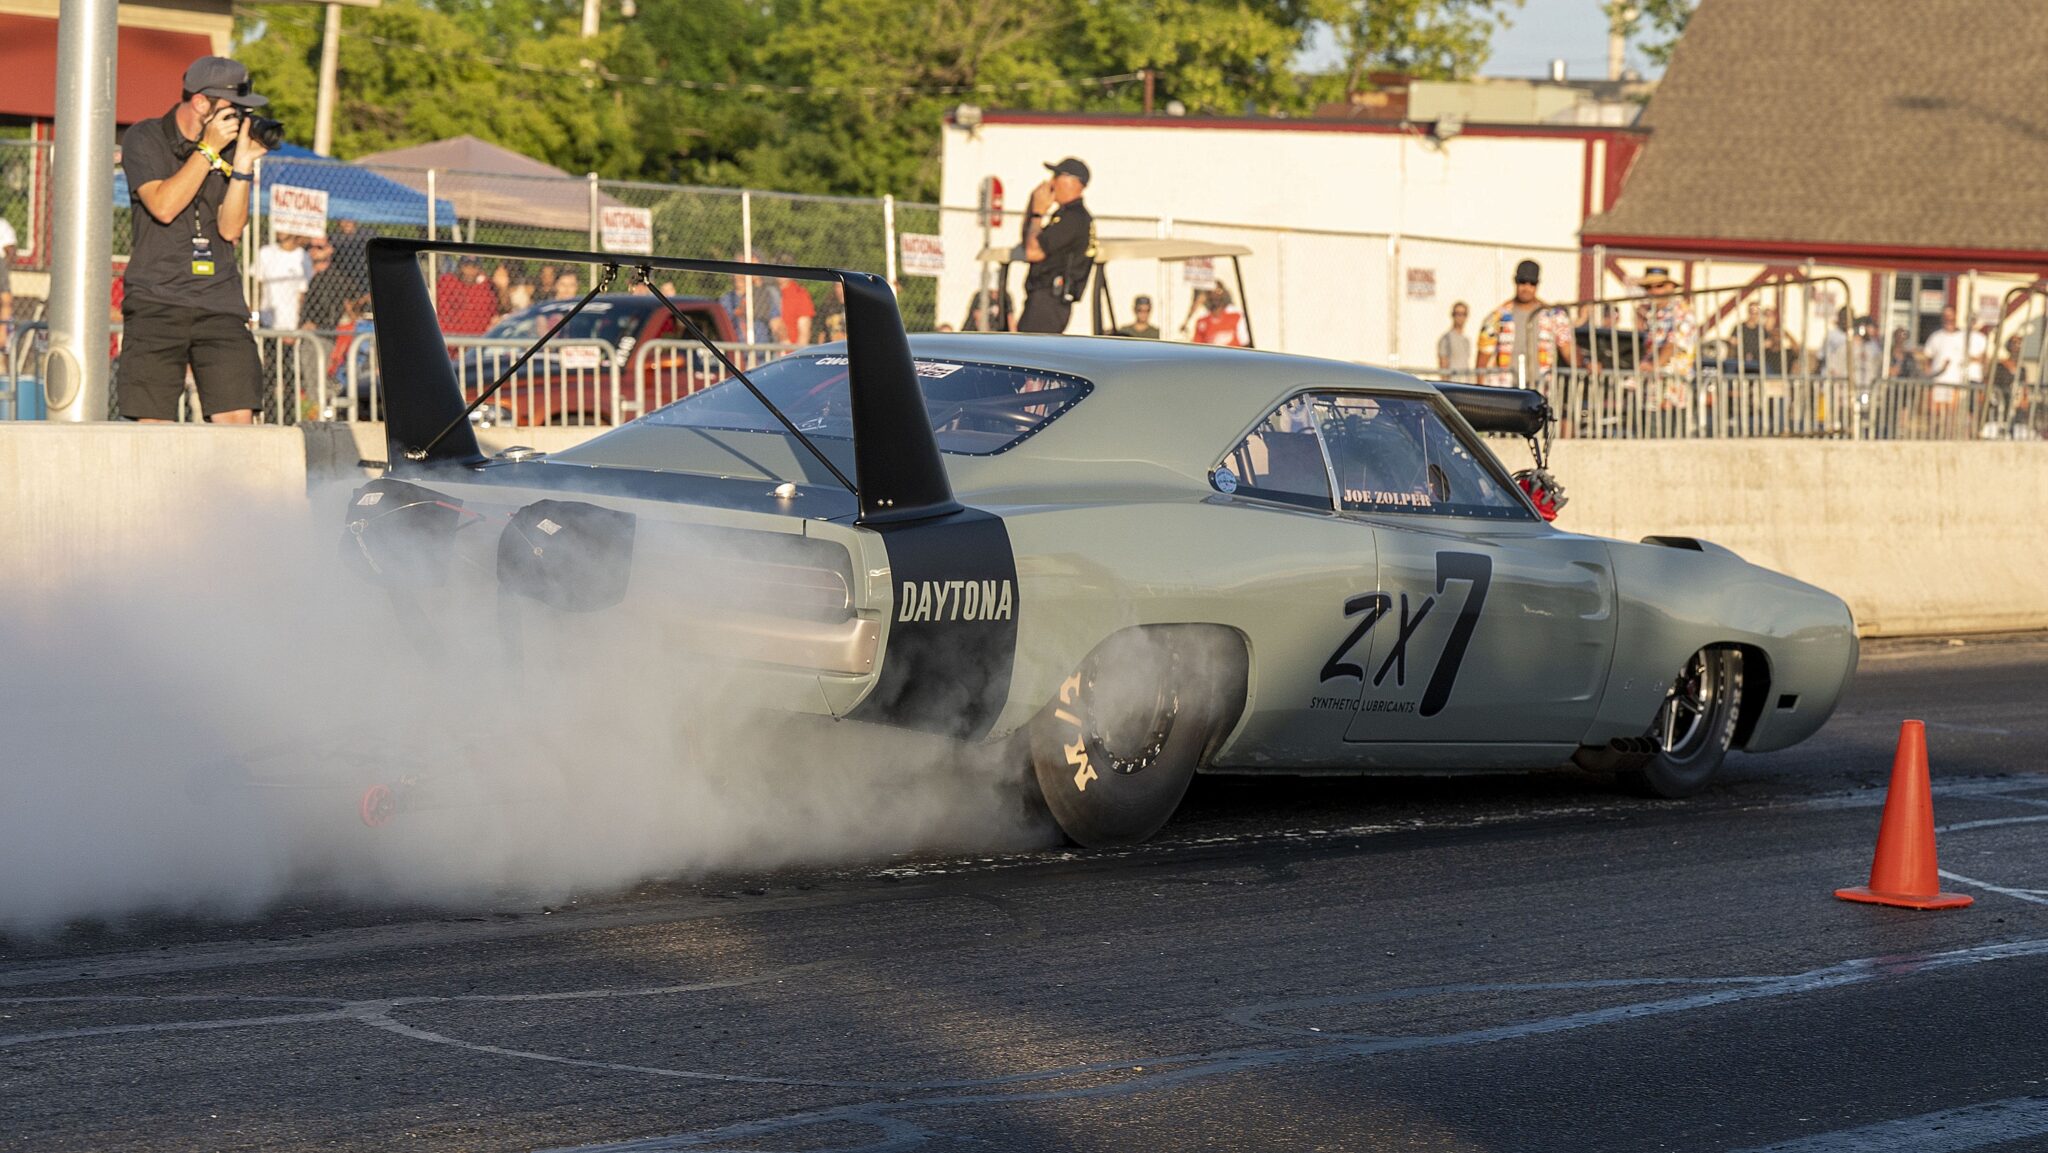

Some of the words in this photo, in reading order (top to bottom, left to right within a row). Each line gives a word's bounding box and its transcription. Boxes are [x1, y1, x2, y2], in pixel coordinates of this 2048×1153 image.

[274, 188, 324, 213] NATIONAL
[1343, 489, 1372, 503] JOE
[1374, 491, 1432, 507] ZOLPER
[898, 579, 1013, 622] DAYTONA
[1309, 696, 1360, 712] SYNTHETIC
[1361, 699, 1415, 713] LUBRICANTS
